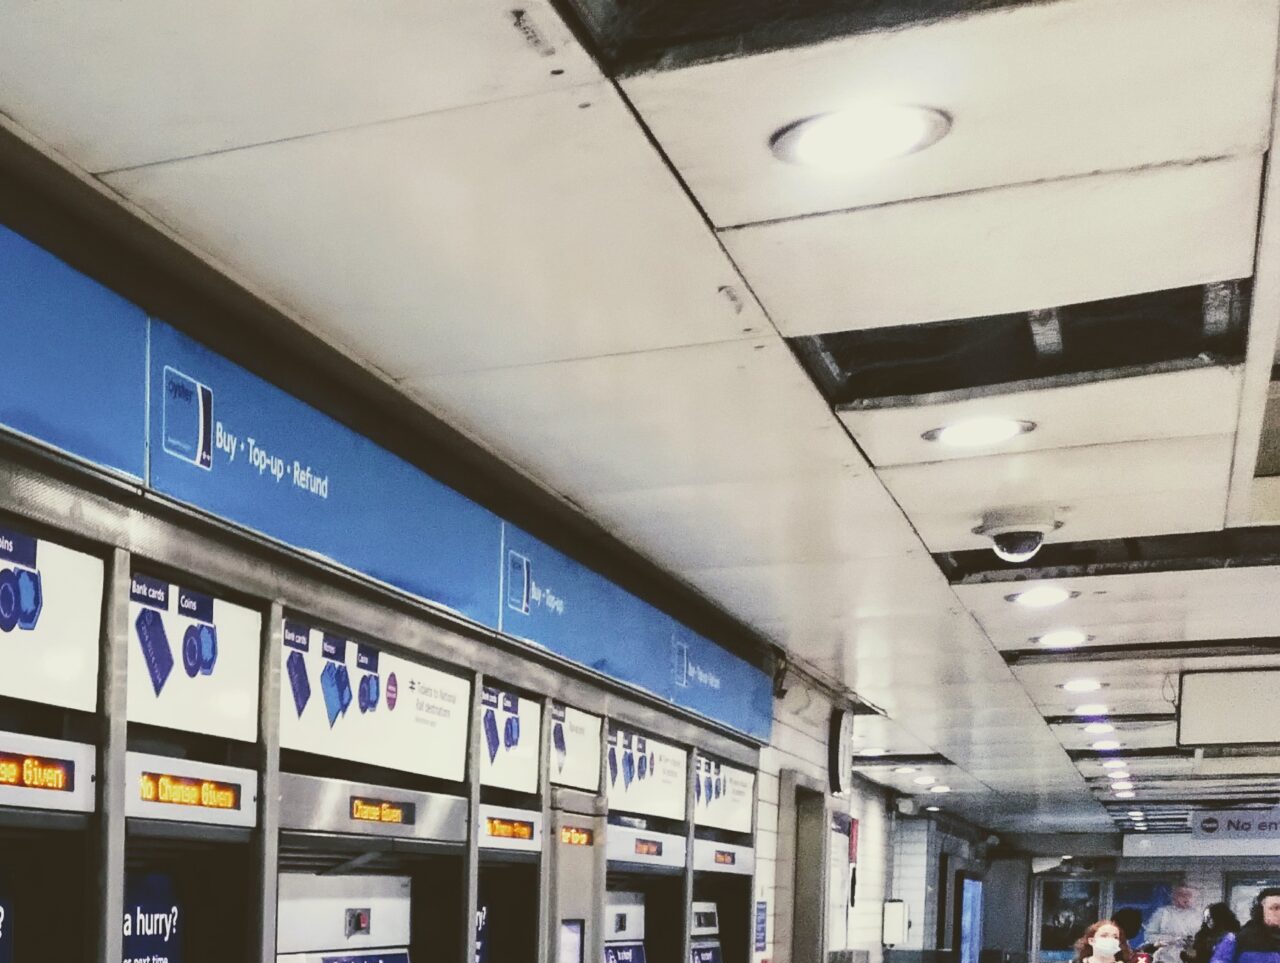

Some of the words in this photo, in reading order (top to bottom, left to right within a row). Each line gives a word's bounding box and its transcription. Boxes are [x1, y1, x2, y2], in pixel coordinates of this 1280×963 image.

[216, 421, 237, 461] Buy
[248, 438, 284, 482] Top-up
[293, 461, 328, 499] Refund
[132, 580, 147, 595] Bank
[148, 588, 165, 601] cards
[180, 595, 197, 611] Coins
[23, 759, 64, 788] Given
[1227, 819, 1251, 831] No
[1258, 819, 1280, 831] en
[123, 913, 132, 936] a
[136, 906, 178, 942] hurry?
